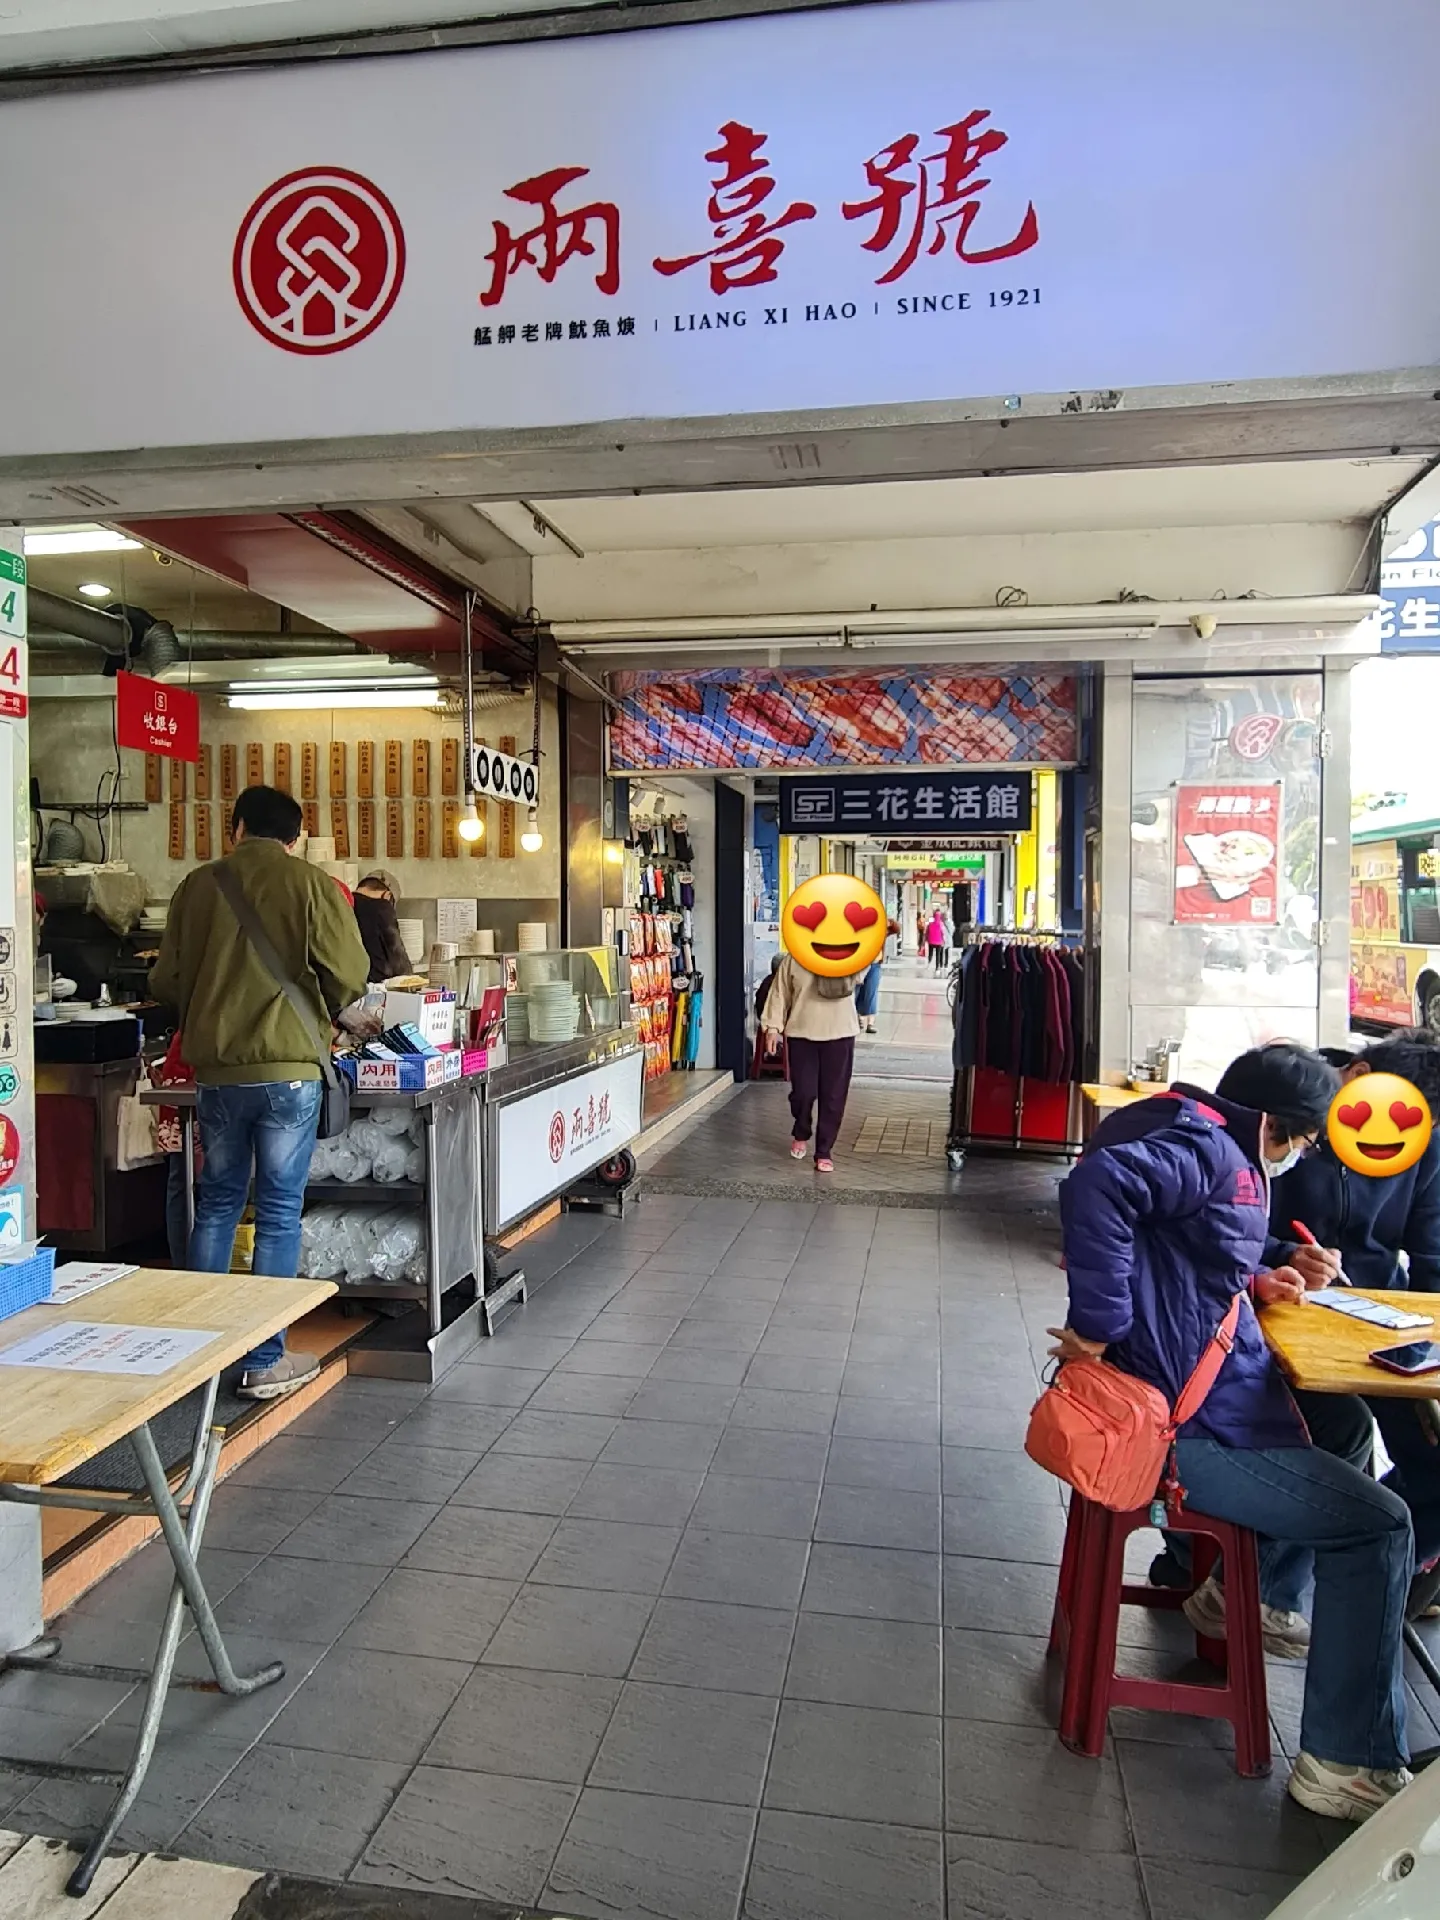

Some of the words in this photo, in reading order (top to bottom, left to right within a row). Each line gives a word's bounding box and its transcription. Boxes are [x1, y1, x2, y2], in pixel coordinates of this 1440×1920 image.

[480, 110, 1039, 306] 兩喜號
[674, 311, 747, 332] LIANG
[764, 307, 789, 325] XI
[805, 303, 857, 322] HAO
[897, 293, 971, 314] SINCE
[989, 288, 1041, 308] 1921
[143, 711, 178, 735] 收銀台
[150, 736, 173, 748] Cashier
[841, 784, 1020, 821] 三花生活館
[361, 1063, 396, 1077] 內用
